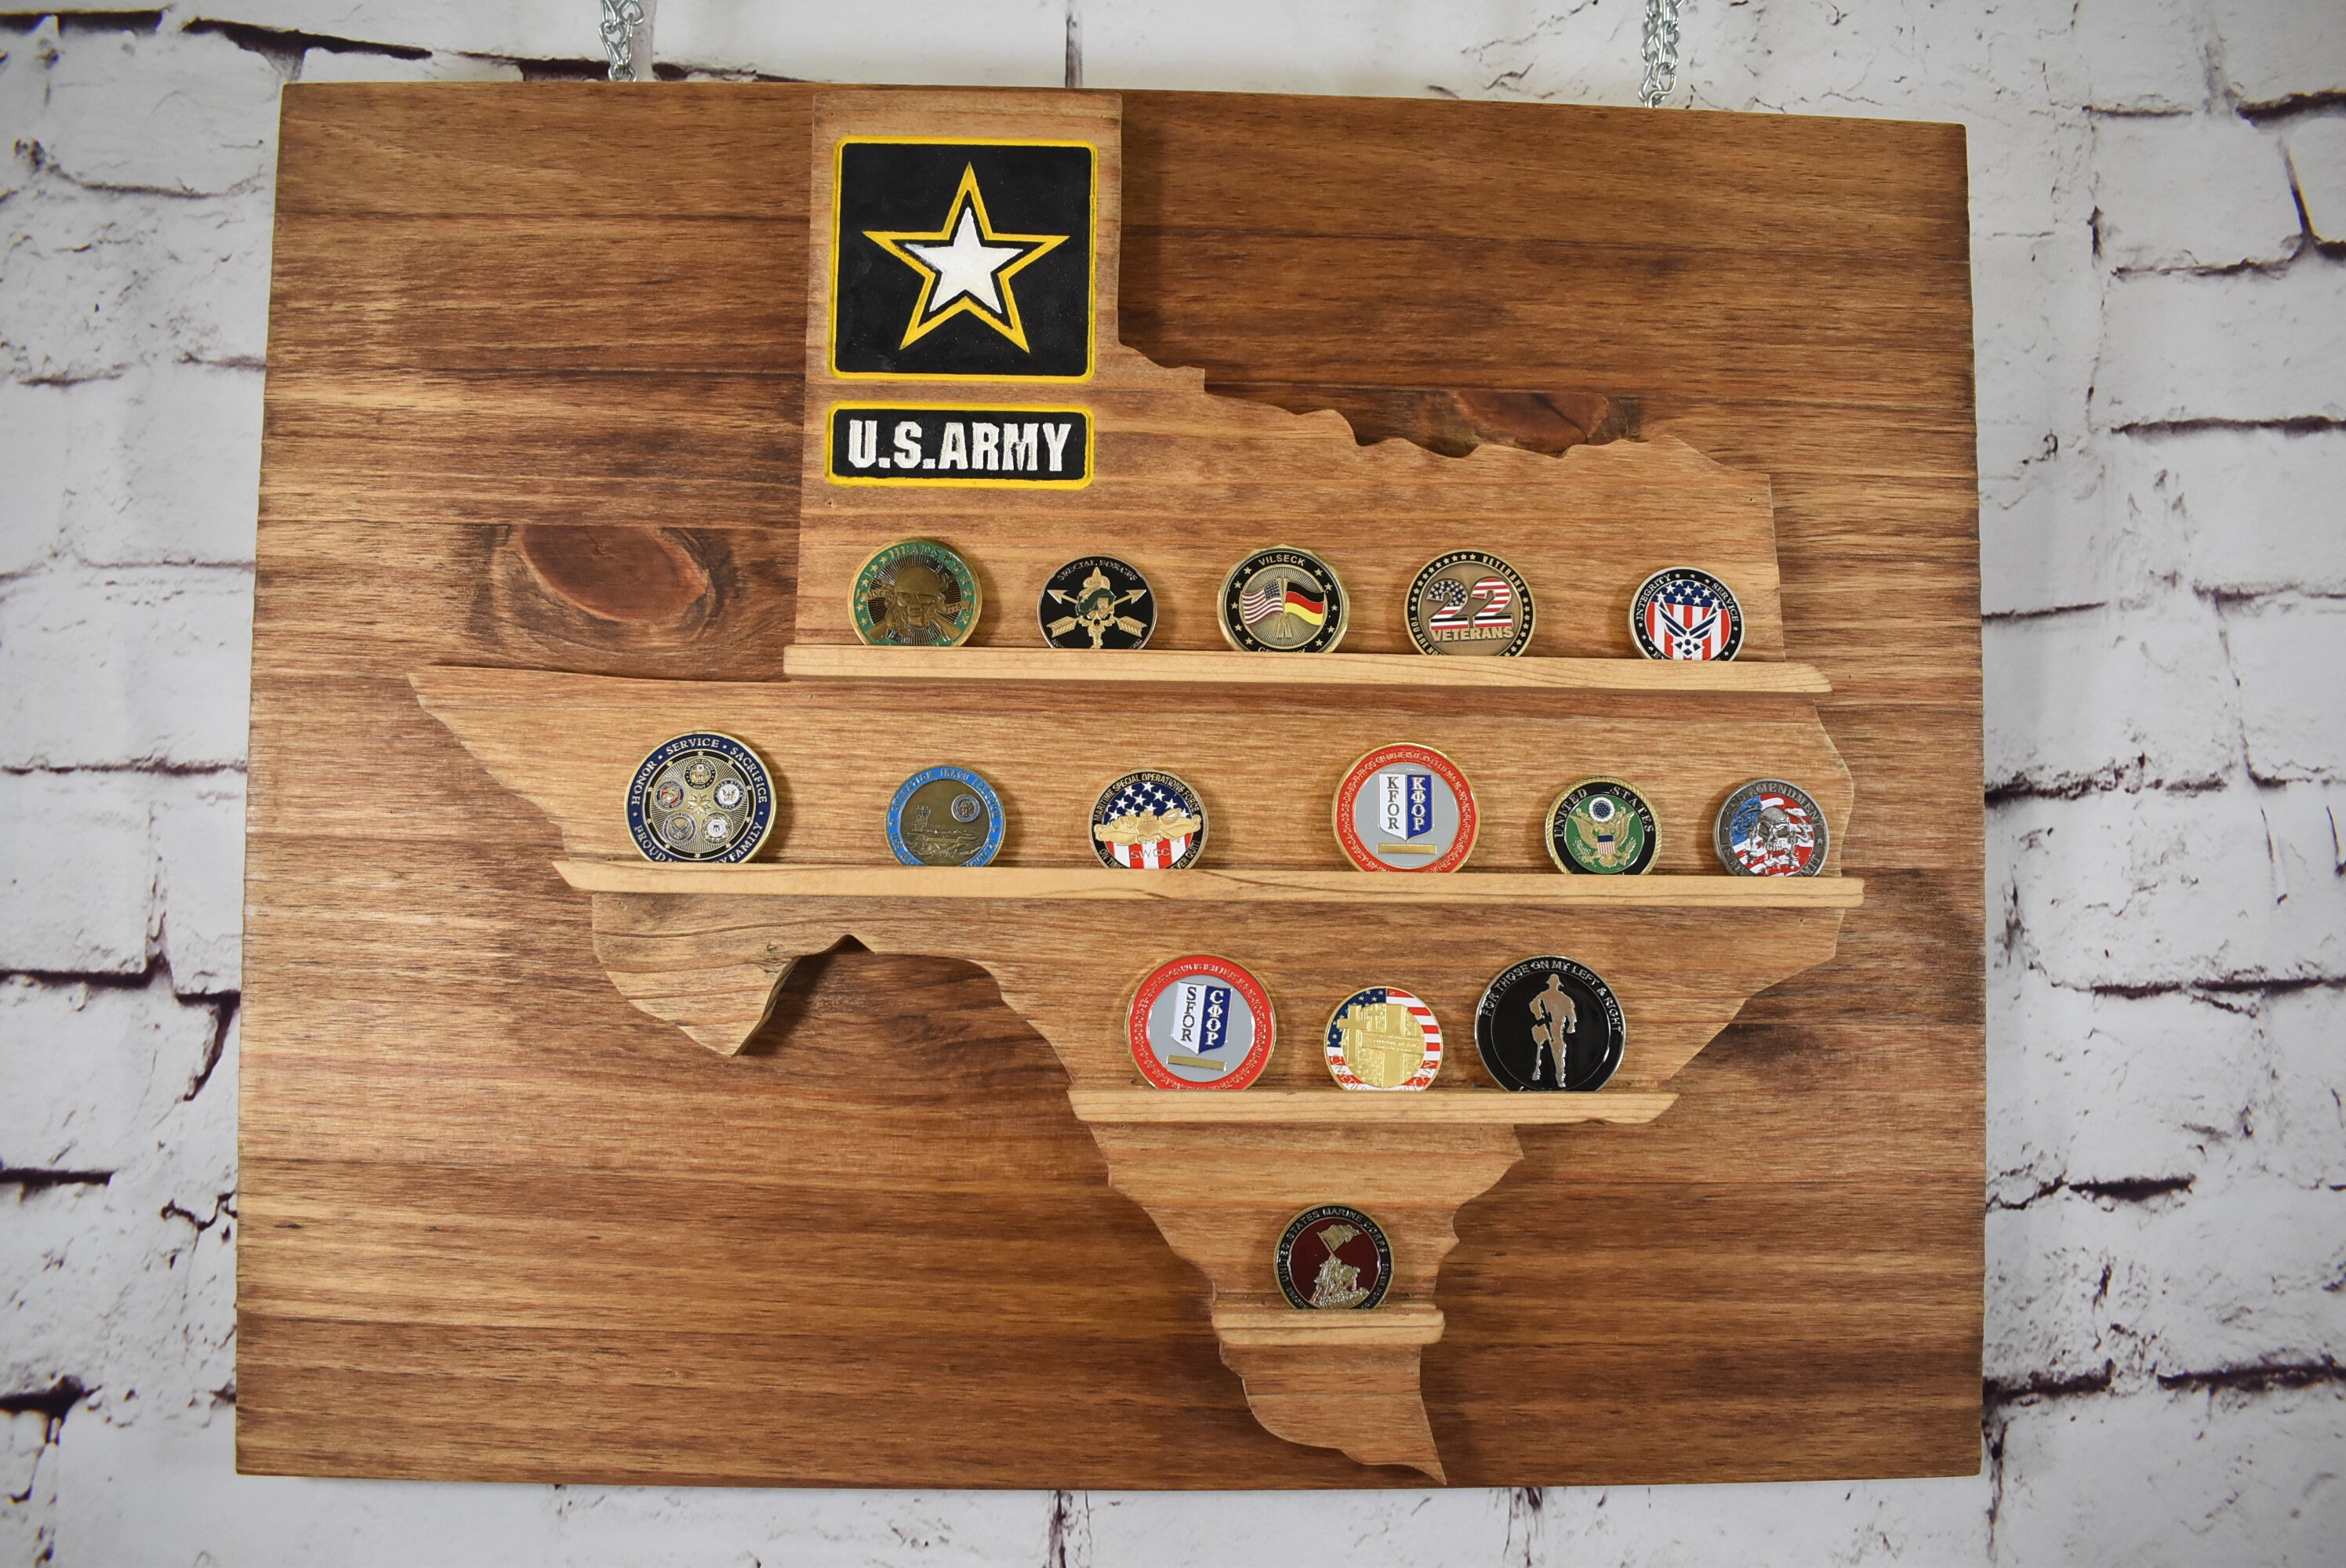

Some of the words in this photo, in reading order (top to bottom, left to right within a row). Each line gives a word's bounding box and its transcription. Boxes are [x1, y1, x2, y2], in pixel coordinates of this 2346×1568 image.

[888, 545, 942, 559] HEADS
[1058, 560, 1095, 581] SPECIAL
[1099, 560, 1138, 581] FORCES
[1258, 554, 1306, 567] VILSECK
[1483, 555, 1525, 593] VETERANS
[946, 604, 963, 614] 1775
[1427, 577, 1514, 631] 22
[1636, 573, 1671, 621] INTEGRITY
[1711, 582, 1739, 622] SERVICE
[1411, 616, 1421, 633] YOU
[1416, 633, 1430, 649] ARE
[1427, 646, 1443, 655] NO
[1431, 626, 1514, 641] VETERANS
[631, 760, 658, 805] HONOR
[666, 738, 721, 755] SERVICE
[730, 746, 768, 803] SACRIFICE
[892, 771, 935, 811] OPERATION
[940, 769, 969, 782] IRAQI
[972, 779, 1002, 818] FREEDOM
[1093, 788, 1115, 822] MARITIME
[1113, 775, 1140, 792] SPECIAL
[1142, 773, 1185, 793] OPERATIONS
[1182, 790, 1200, 812] FORCE
[1554, 788, 1588, 838] UNITED
[1612, 786, 1654, 833] STATES
[1727, 793, 1745, 815] 2ND
[1749, 782, 1824, 828] AMENDMENT
[634, 825, 666, 862] PROUD
[728, 822, 764, 862] FAMILY
[1099, 848, 1110, 860] ON
[1130, 848, 1171, 860] SWCC
[1483, 993, 1499, 1017] FOR
[1494, 964, 1530, 992] THOSE
[1531, 960, 1549, 970] ON
[1552, 960, 1571, 971] MY
[1572, 965, 1600, 986] LEFT
[1597, 987, 1607, 997] &
[1603, 996, 1623, 1033] RIGHT
[1278, 1243, 1290, 1283] UNITED
[1286, 1210, 1320, 1240] STATES
[1323, 1207, 1363, 1222] MARINE
[1363, 1221, 1388, 1253] CORPS
